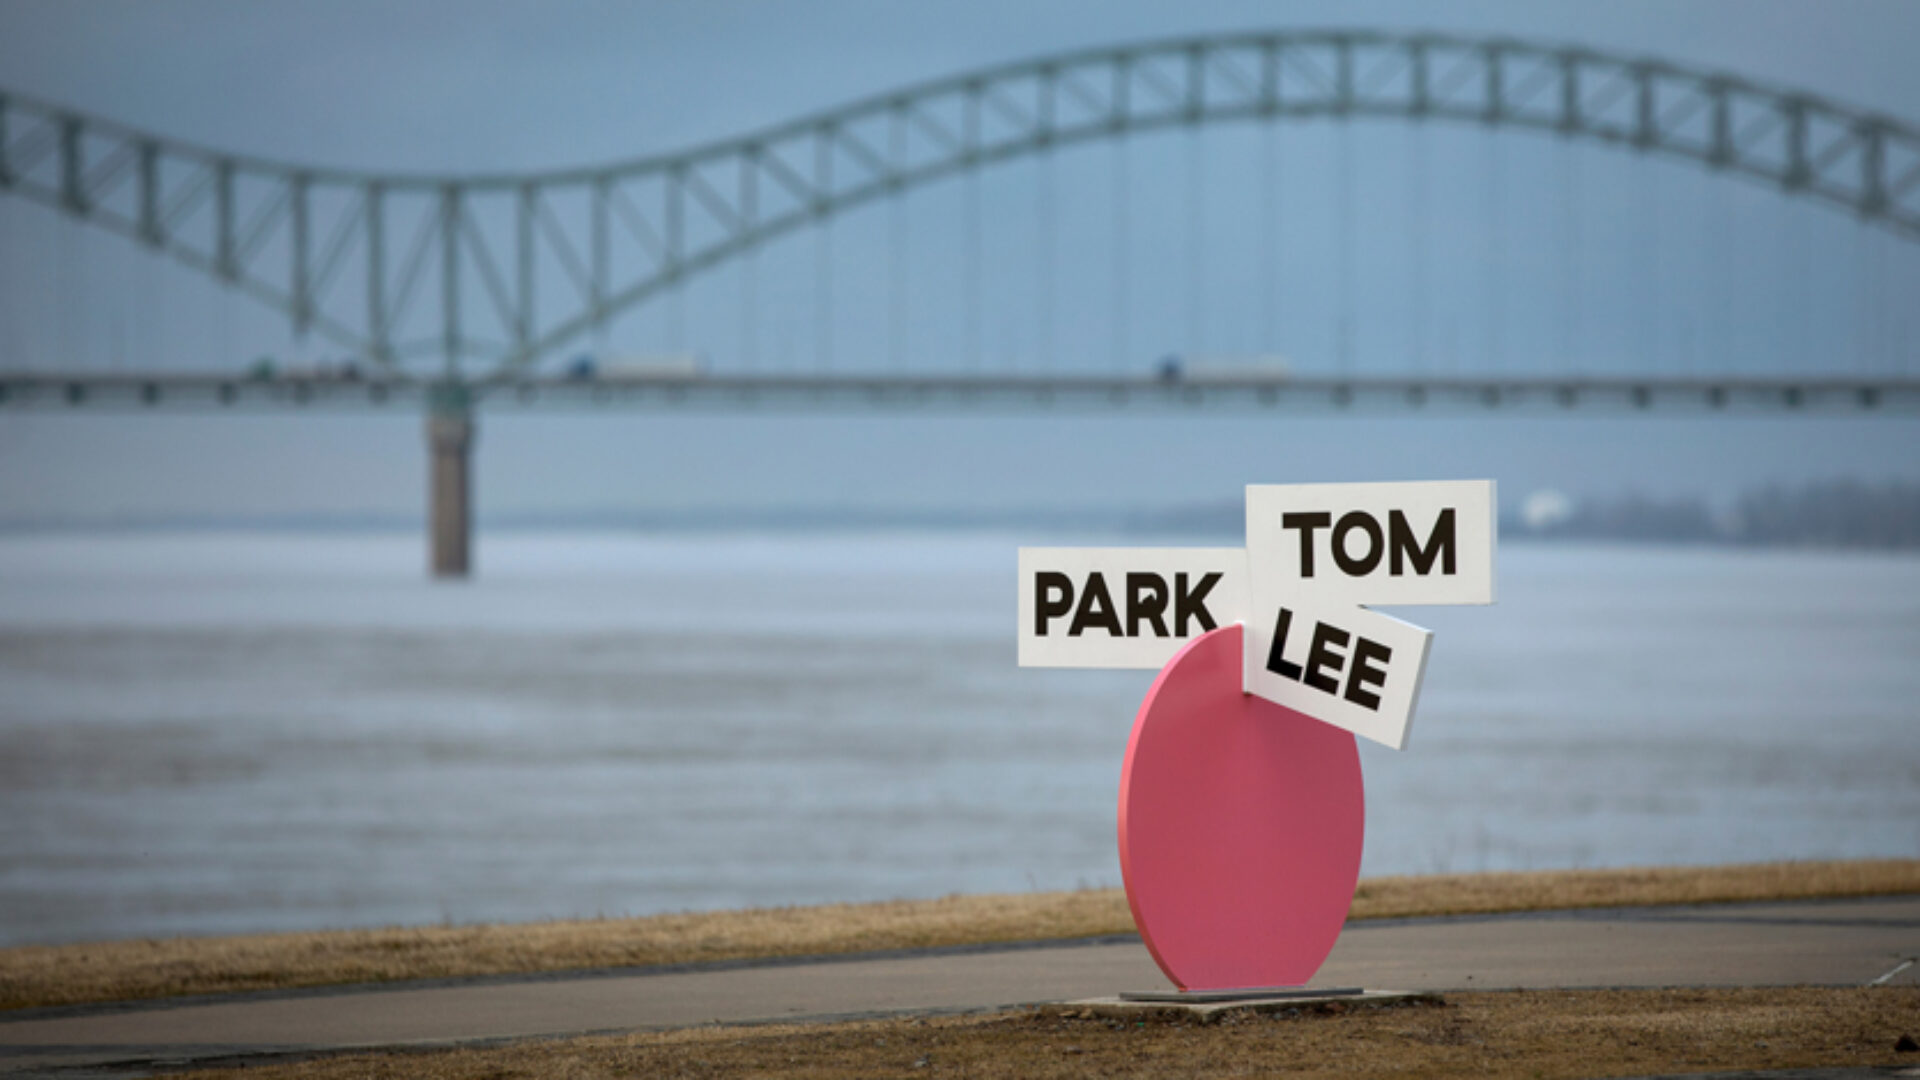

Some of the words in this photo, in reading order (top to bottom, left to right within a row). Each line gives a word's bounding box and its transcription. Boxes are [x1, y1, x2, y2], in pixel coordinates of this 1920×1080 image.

[1282, 508, 1456, 578] TOM
[1034, 571, 1224, 638] PARK
[1265, 607, 1393, 712] LEE
